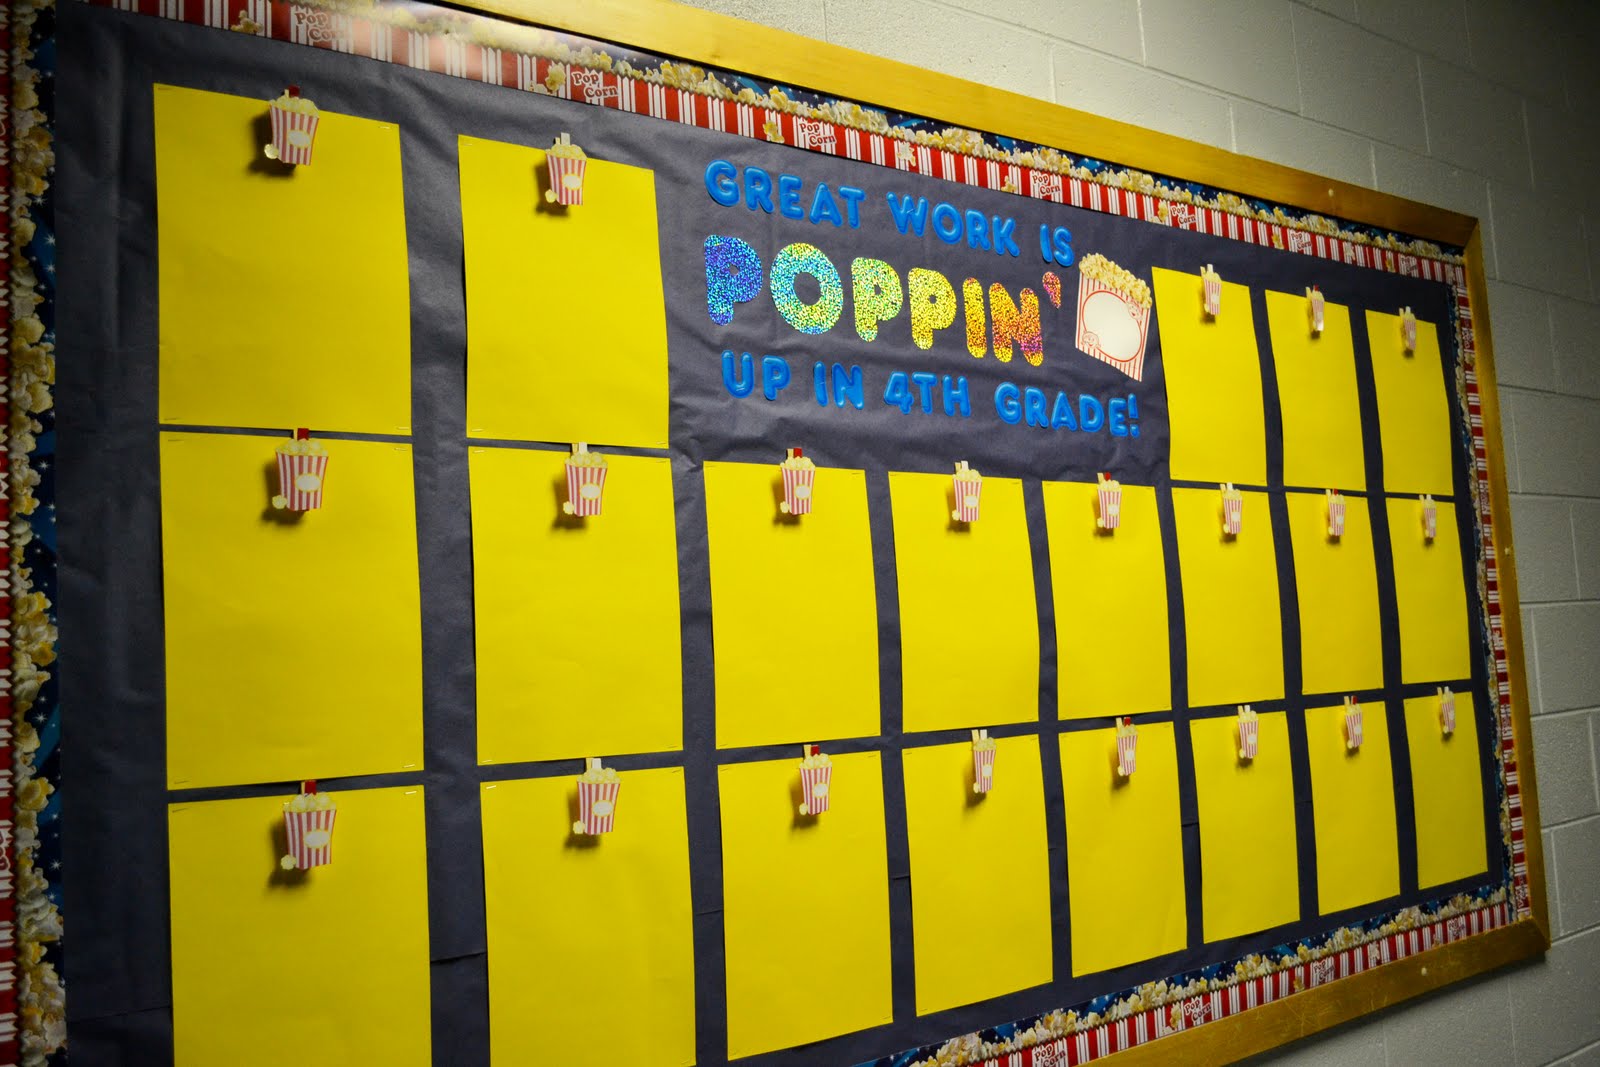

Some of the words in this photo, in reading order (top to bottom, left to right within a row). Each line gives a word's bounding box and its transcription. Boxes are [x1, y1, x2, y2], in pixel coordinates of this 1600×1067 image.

[572, 72, 599, 84] Pop
[585, 87, 617, 98] Corn
[799, 123, 820, 133] Pop
[809, 135, 836, 145] Corn
[1032, 174, 1049, 184] Pop
[1040, 185, 1060, 195] Corn
[704, 159, 866, 229] GREAT
[887, 192, 1020, 257] WORK
[1040, 223, 1074, 267] IS
[704, 234, 1061, 366] POPPIN'
[721, 350, 791, 401] UP
[813, 361, 864, 410] IN
[884, 371, 971, 417] 4TH
[994, 381, 1139, 438] GRADE!
[1034, 1045, 1053, 1062] Pop
